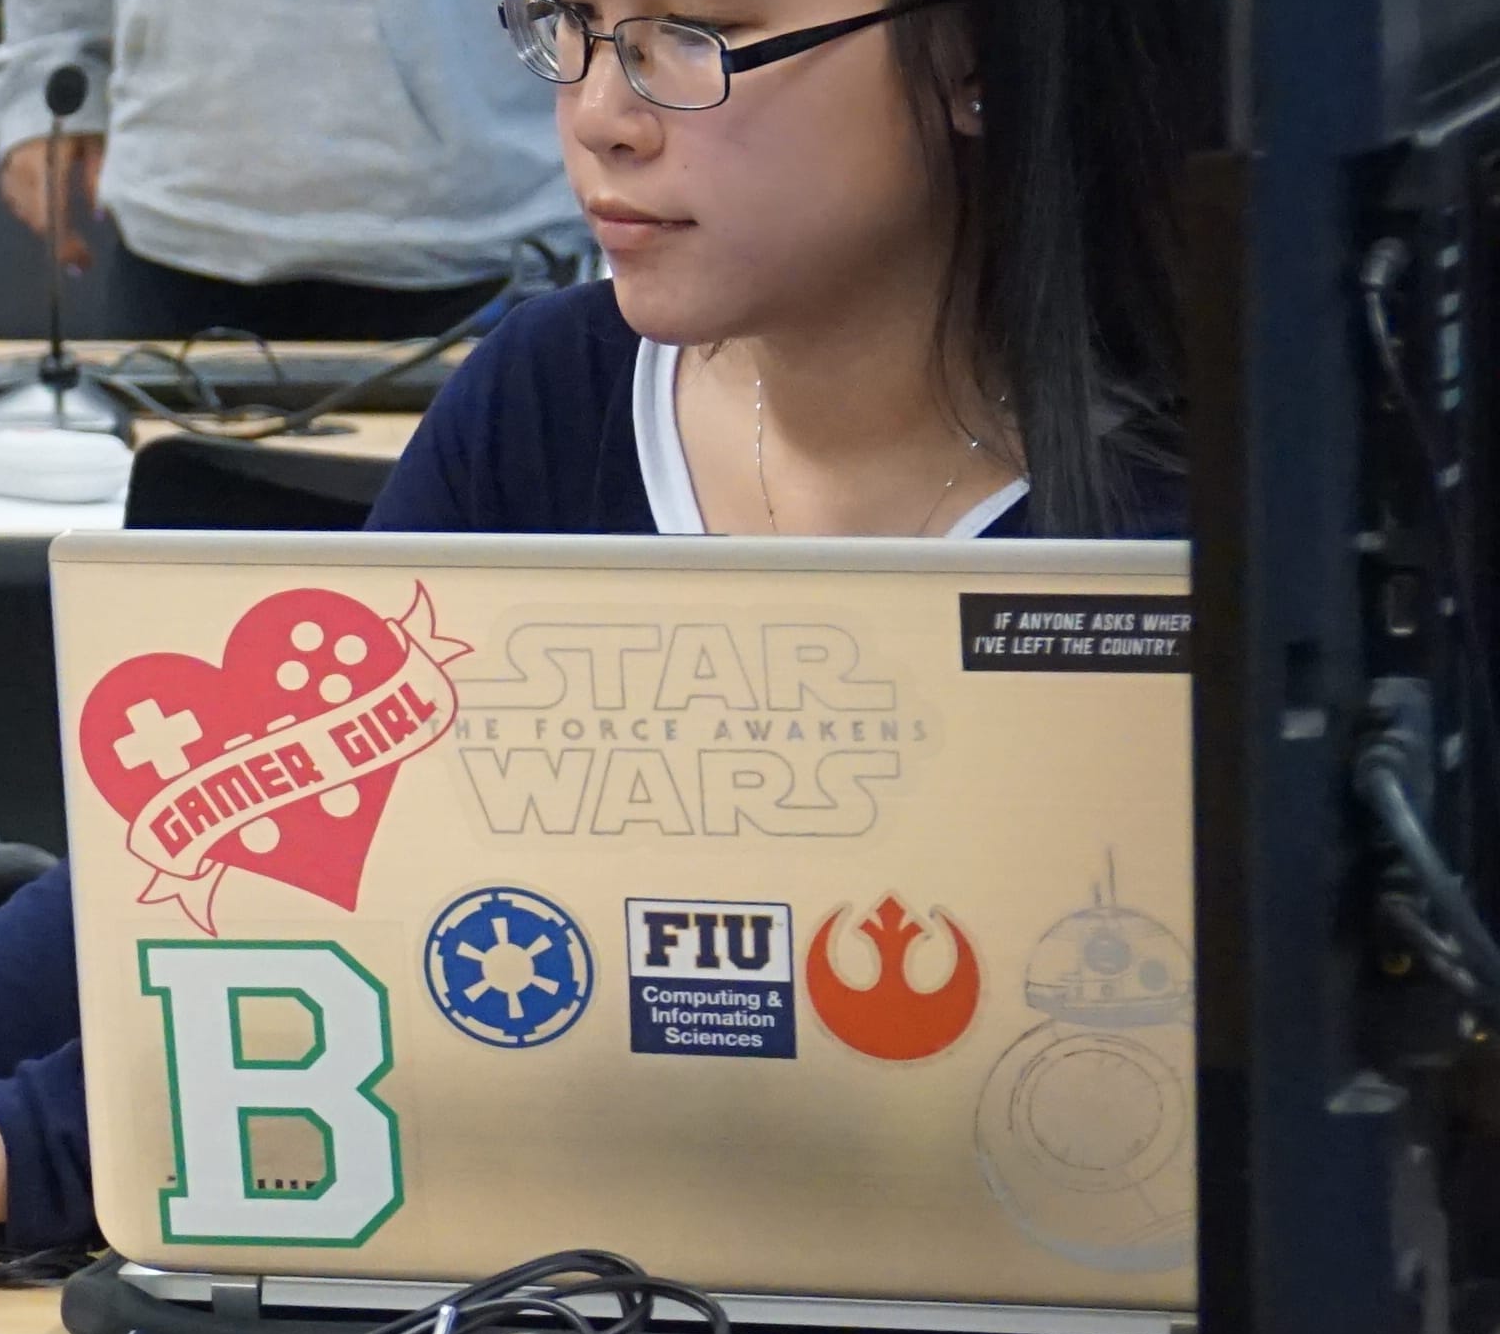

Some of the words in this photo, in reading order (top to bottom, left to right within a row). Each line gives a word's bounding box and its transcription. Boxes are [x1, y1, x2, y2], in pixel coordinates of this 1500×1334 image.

[994, 612, 1012, 631] IF
[1018, 612, 1085, 631] ANYONE
[1091, 613, 1135, 632] ASKS
[1142, 614, 1192, 632] WHER
[974, 635, 1006, 655] I'VE
[1011, 636, 1055, 655] LEFT
[1061, 637, 1094, 655] THE
[455, 622, 897, 712] STAR
[535, 718, 679, 742] FORCE
[713, 719, 928, 743] AWAKENS
[148, 740, 326, 860] GAMER
[326, 681, 438, 769] GIRL
[458, 747, 901, 837] WARS
[643, 911, 774, 971] FIU
[642, 985, 761, 1011] Computing
[766, 990, 783, 1008] &
[651, 1006, 776, 1028] Information
[664, 1026, 764, 1048] Sciences
[136, 938, 405, 1249] B
